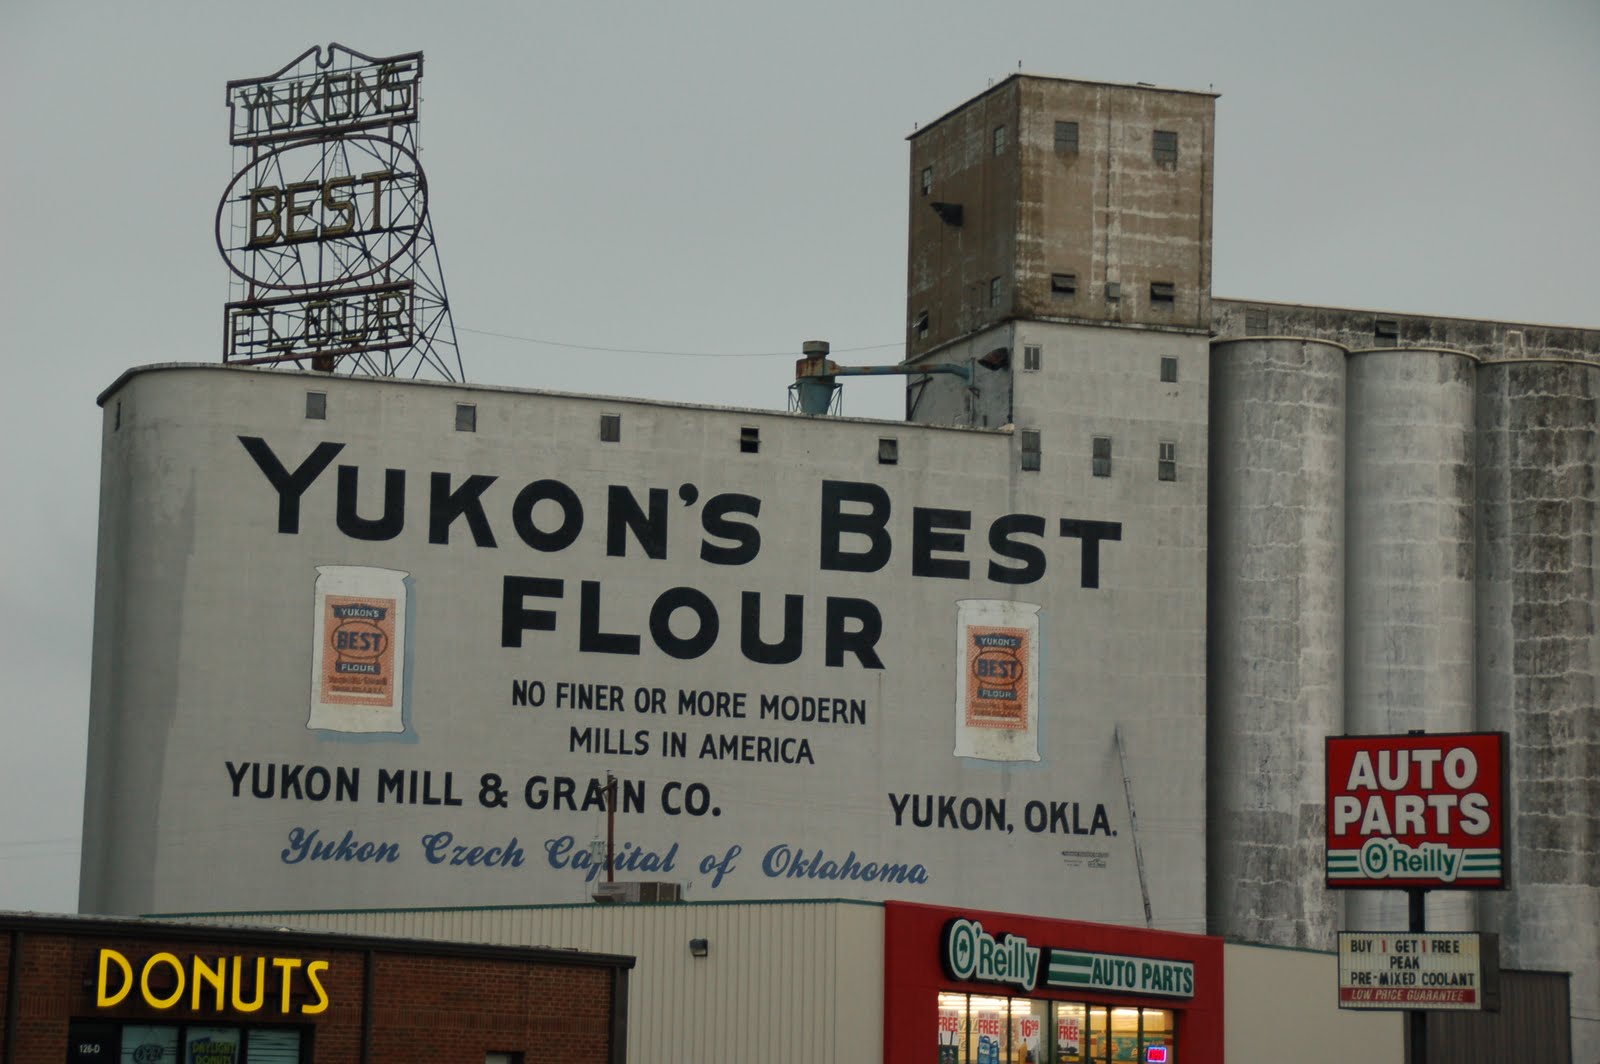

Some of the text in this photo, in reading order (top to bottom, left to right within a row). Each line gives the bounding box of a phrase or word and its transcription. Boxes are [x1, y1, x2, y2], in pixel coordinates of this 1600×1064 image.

[248, 170, 393, 247] BEST
[229, 291, 407, 355] FLOUR
[237, 435, 1122, 588] YUKON'S BEST
[341, 607, 380, 618] YUKON'S
[502, 575, 886, 670] FLOUR
[337, 630, 383, 651] BEST
[341, 663, 375, 673] FLOUR
[977, 658, 1018, 679] BEST
[511, 680, 866, 726] NO FINER OR MORE MODERN
[982, 689, 1012, 698] FLOUR
[569, 726, 815, 765] MILLS IN AMERICA
[1346, 747, 1478, 791] AUTO
[225, 761, 721, 817] YUKON MILL & GRAIN CO.
[888, 793, 1118, 837] YUKON, OKLA.
[1334, 793, 1491, 836] PARTS
[281, 827, 399, 865] Yukon
[422, 831, 525, 868] Czech
[699, 844, 742, 888] of
[762, 843, 929, 885] Oklahoma
[1365, 843, 1457, 876] O'Reilly
[952, 924, 1193, 994] O'Reilly AUTO PARTS
[1351, 940, 1459, 953] BUY 1 GET 1 FREE
[1390, 956, 1420, 969] PEAK
[97, 949, 329, 1014] DONUTS
[1351, 972, 1475, 986] PRE-MIXED COOLANT
[1352, 989, 1464, 1001] LOW PRICE GUARANTEE
[939, 1017, 959, 1032] FREE
[978, 1019, 999, 1035] FREE
[1058, 1026, 1079, 1041] FREE
